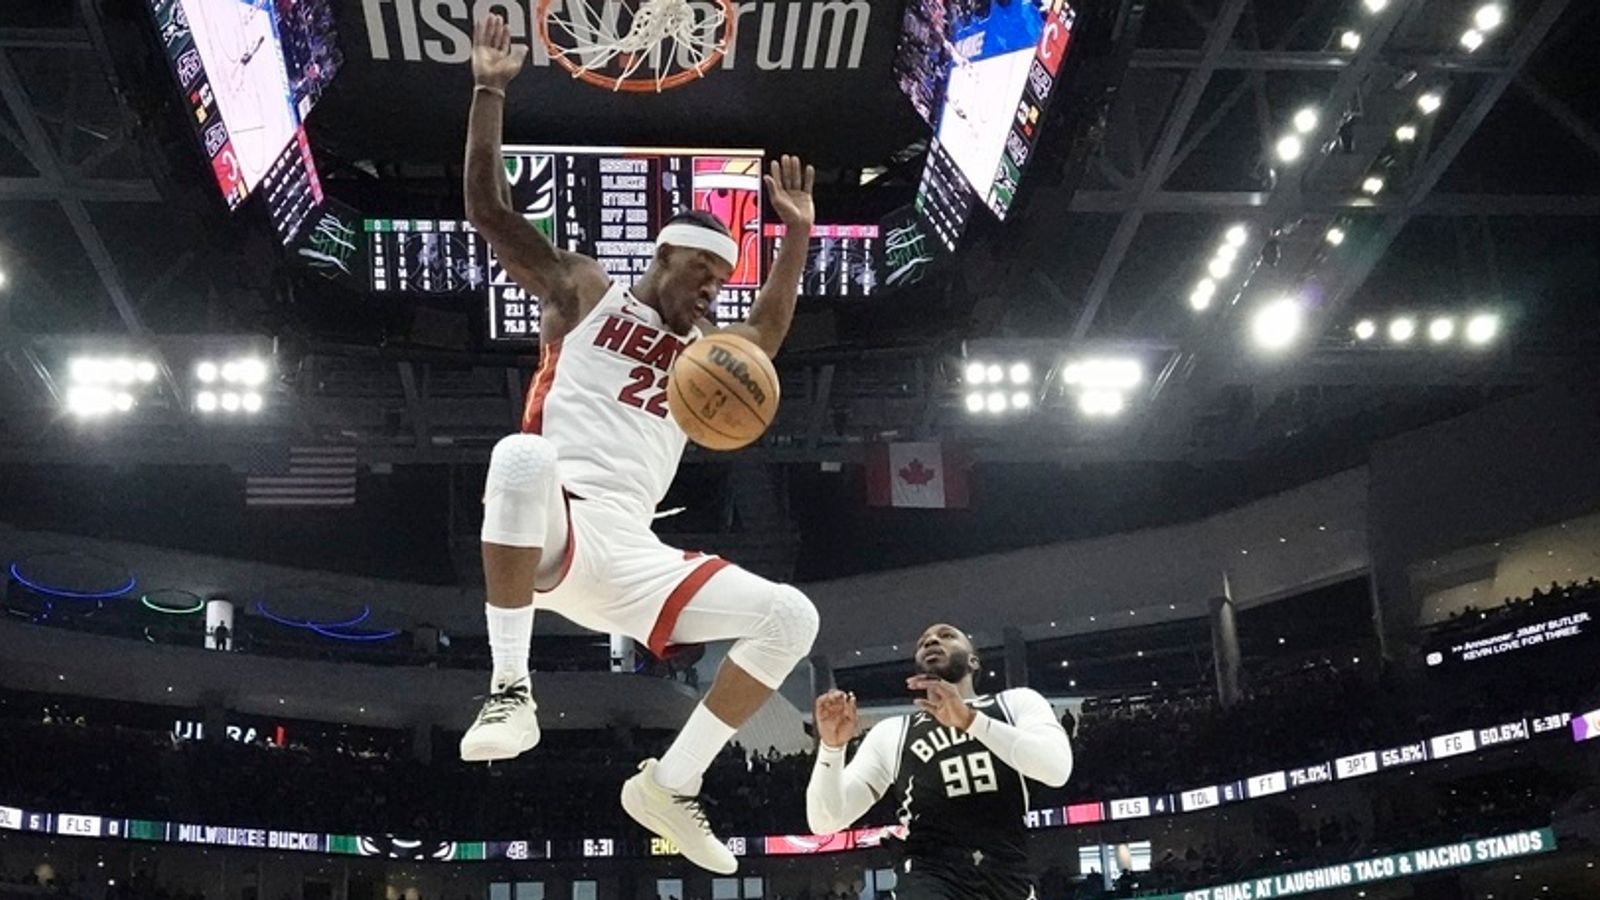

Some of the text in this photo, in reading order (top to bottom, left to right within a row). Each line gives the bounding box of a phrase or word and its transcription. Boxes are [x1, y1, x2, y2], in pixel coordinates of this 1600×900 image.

[593, 315, 693, 374] HEA
[707, 346, 765, 406] Wilson
[1493, 640, 1520, 653] LOVE
[1521, 633, 1544, 646] FOR
[1444, 736, 1462, 751] FG
[1345, 744, 1423, 773] 3PT 55.6%
[940, 751, 998, 797] 99
[1259, 764, 1328, 792] FT 75.0%
[1118, 798, 1164, 815] FLS 4
[66, 818, 91, 832] FLS
[179, 824, 266, 847] MILWAUKEE
[1256, 878, 1272, 899] AT
[1276, 864, 1350, 895] LAUGHING
[1354, 857, 1394, 881] TACO
[1399, 856, 1411, 873] &
[1415, 844, 1472, 870] NACHO
[1476, 831, 1542, 859] STANDS
